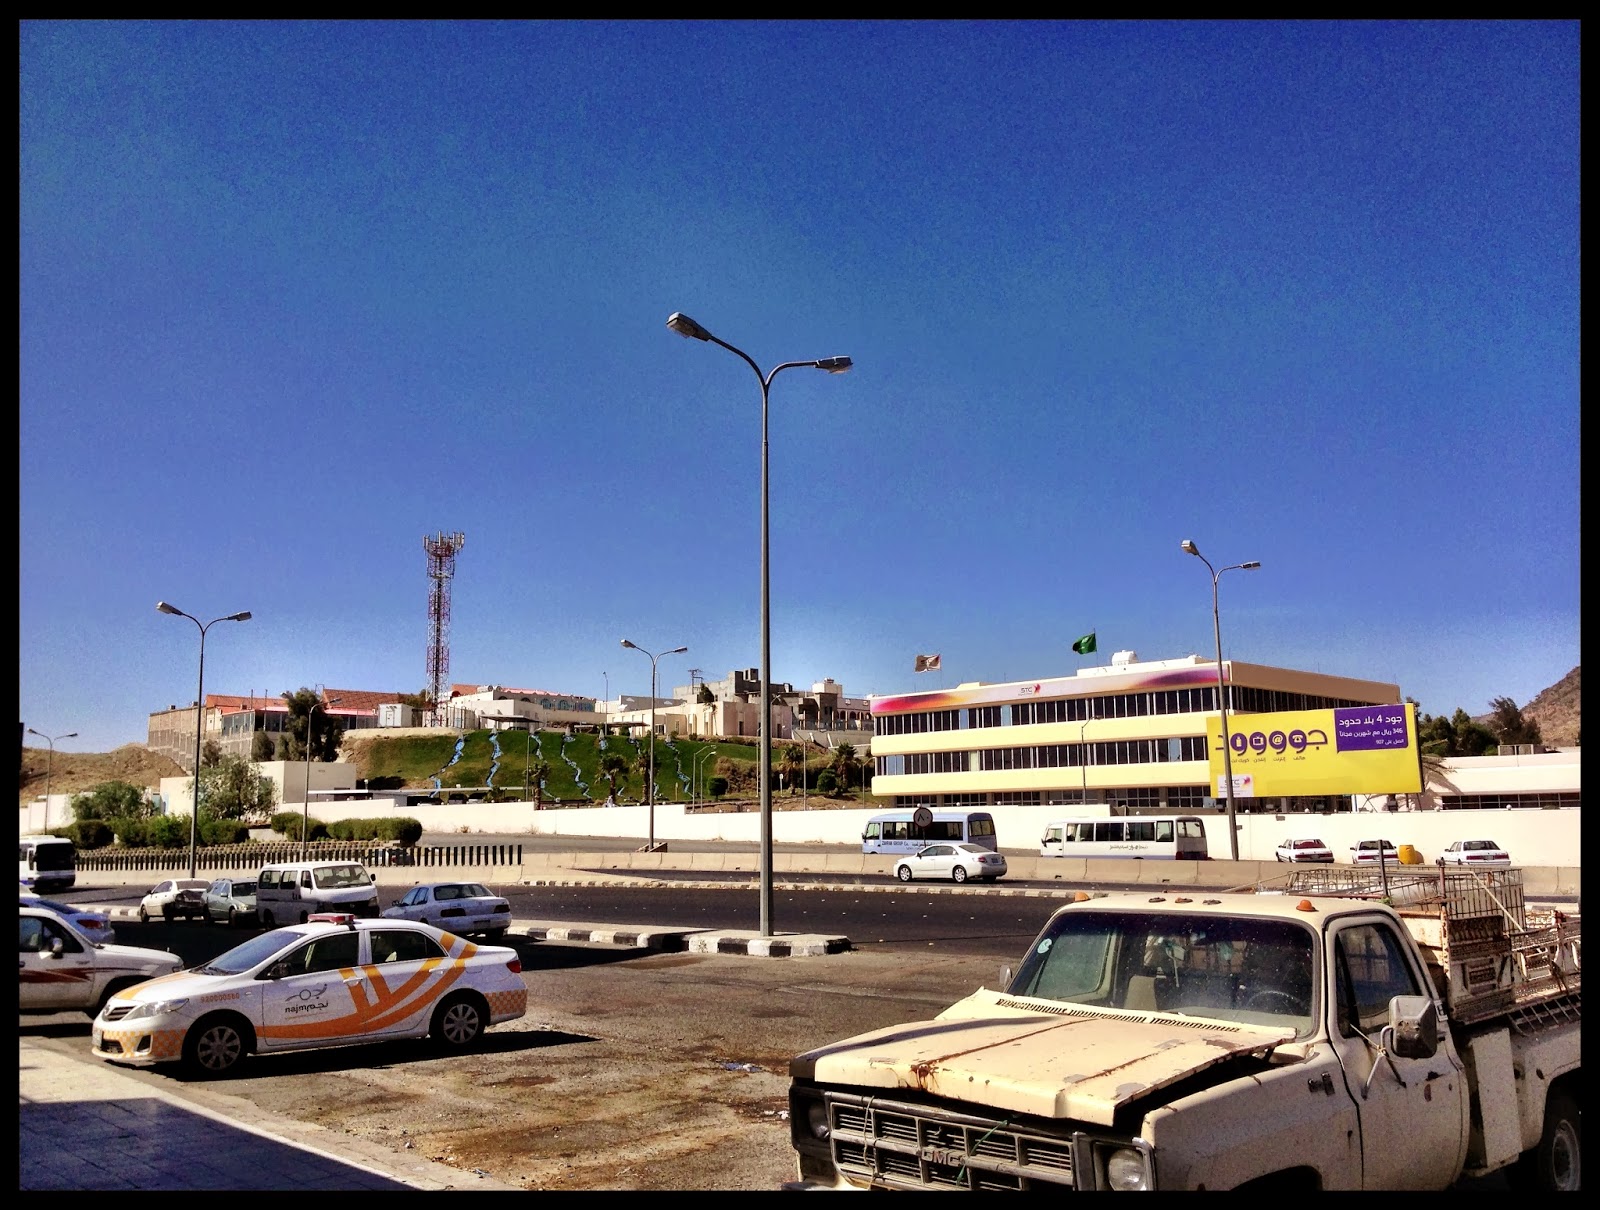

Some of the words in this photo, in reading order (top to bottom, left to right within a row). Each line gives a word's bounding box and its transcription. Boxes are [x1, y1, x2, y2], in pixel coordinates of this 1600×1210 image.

[1339, 718, 1361, 728] حدود
[1363, 716, 1374, 725] بلا
[1376, 714, 1383, 723] 4
[1385, 715, 1402, 725] جود
[285, 1004, 306, 1013] najm
[921, 1148, 960, 1166] GMC
